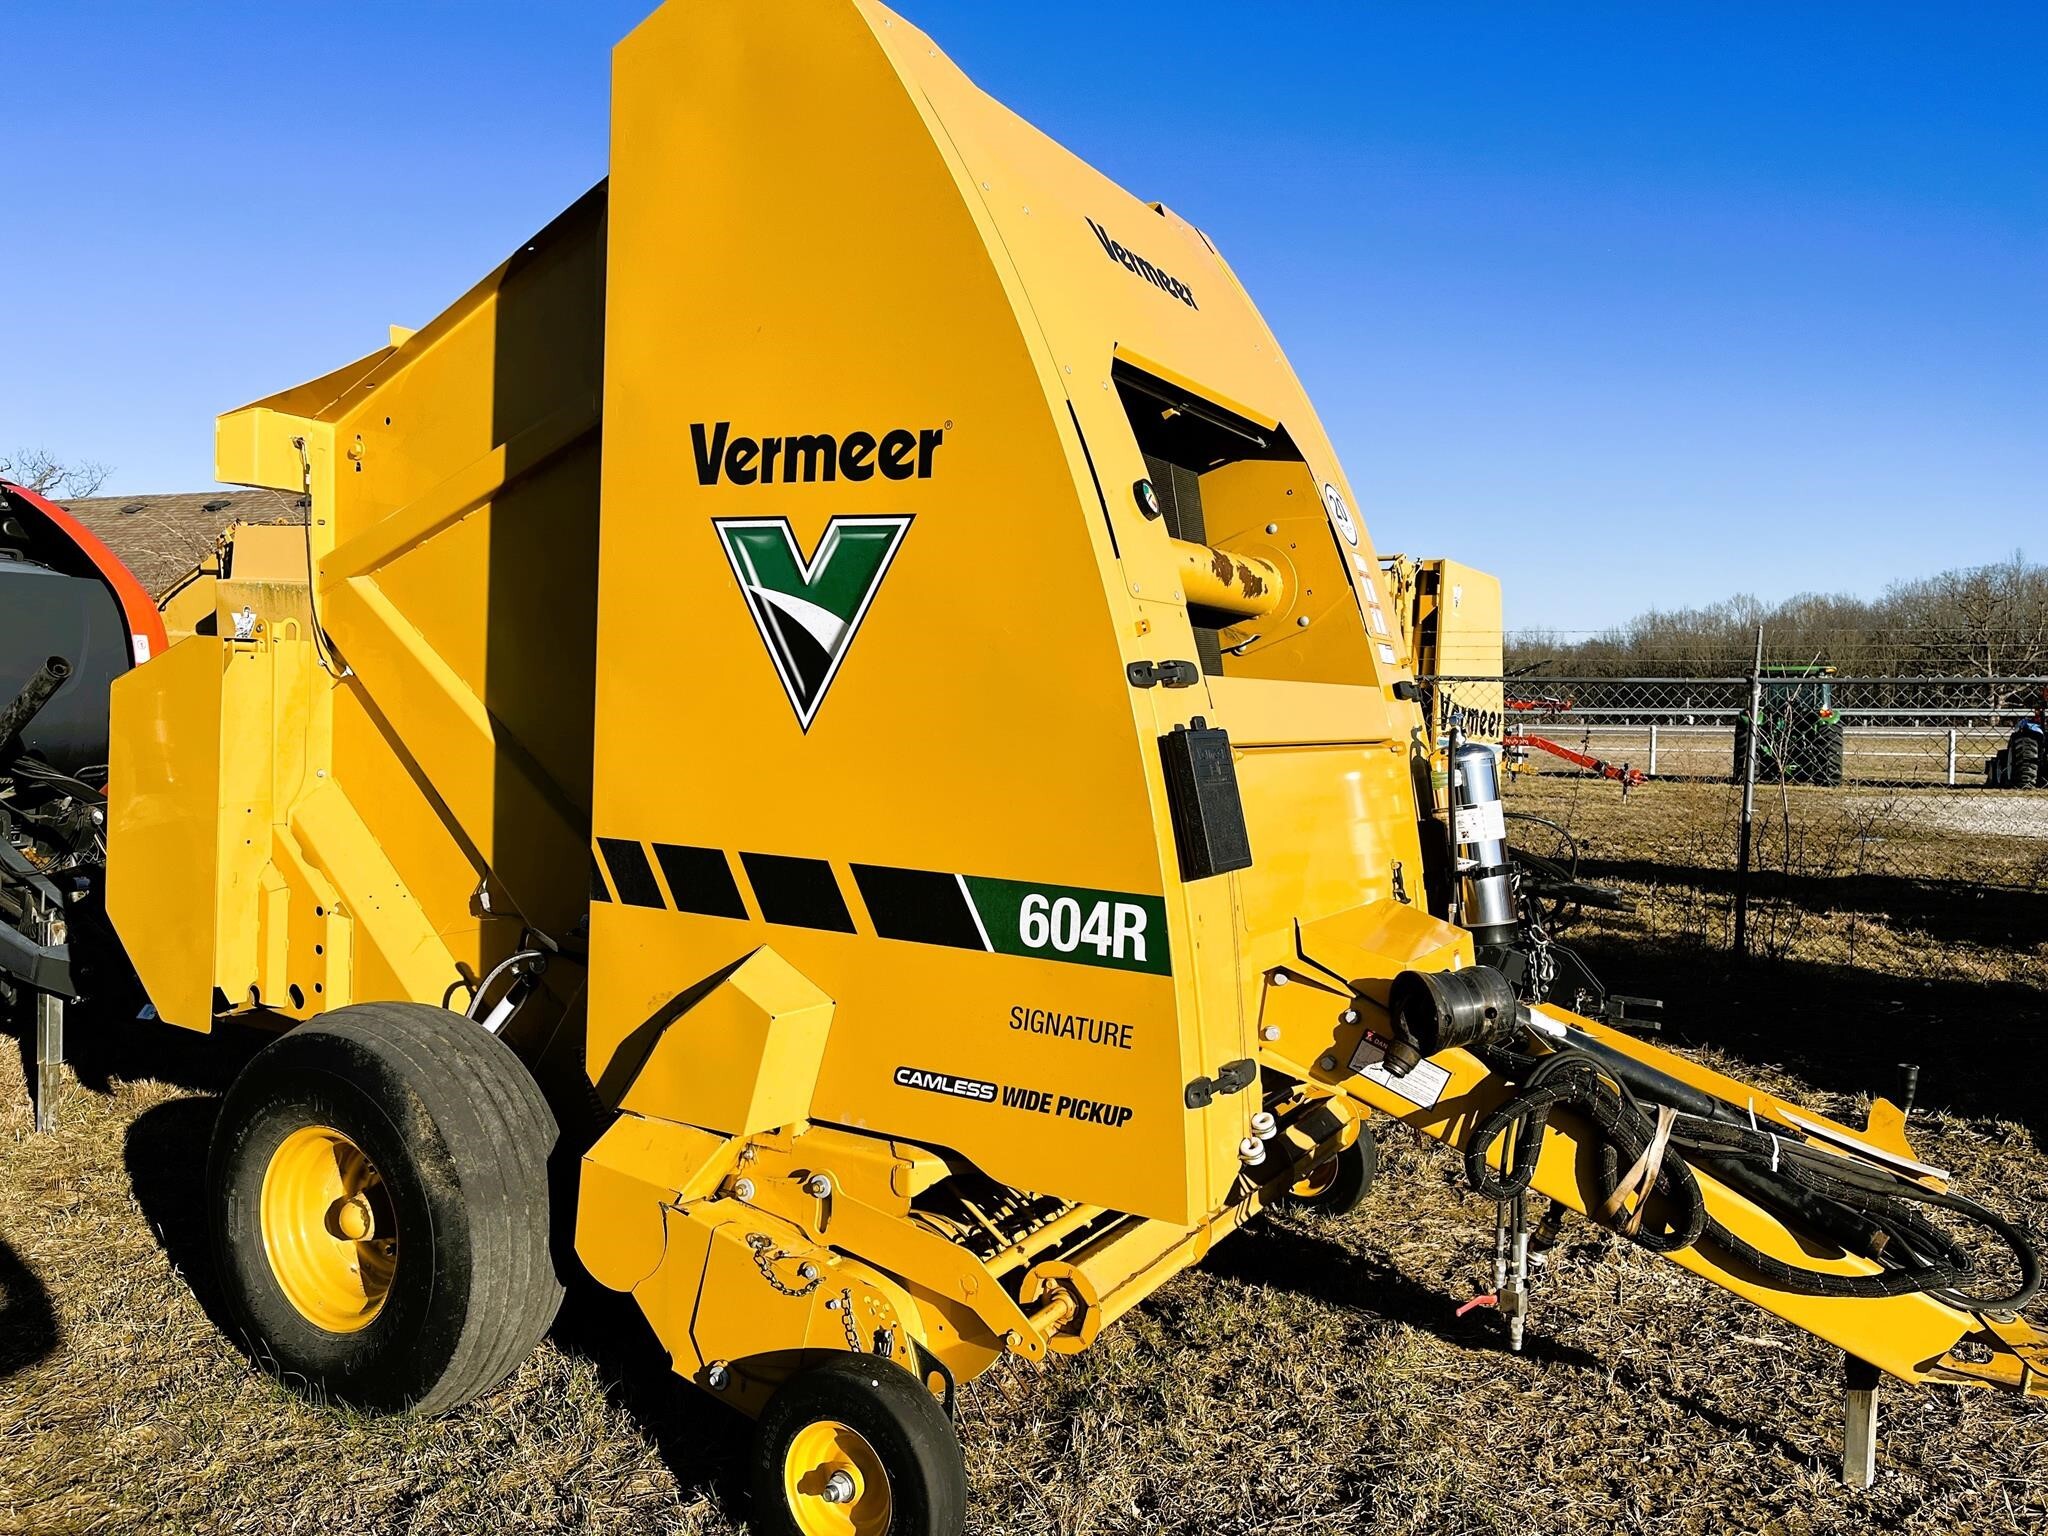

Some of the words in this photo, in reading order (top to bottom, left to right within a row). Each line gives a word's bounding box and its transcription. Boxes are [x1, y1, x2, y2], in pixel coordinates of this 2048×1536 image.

[1084, 216, 1199, 311] Vermeer
[1329, 494, 1348, 522] 20
[1019, 893, 1148, 962] 604R
[1009, 1006, 1134, 1050] SIGNATURE
[896, 1069, 995, 1101] CAMLESS
[1002, 1085, 1054, 1114] WIDE
[1055, 1095, 1133, 1128] PICKUP
